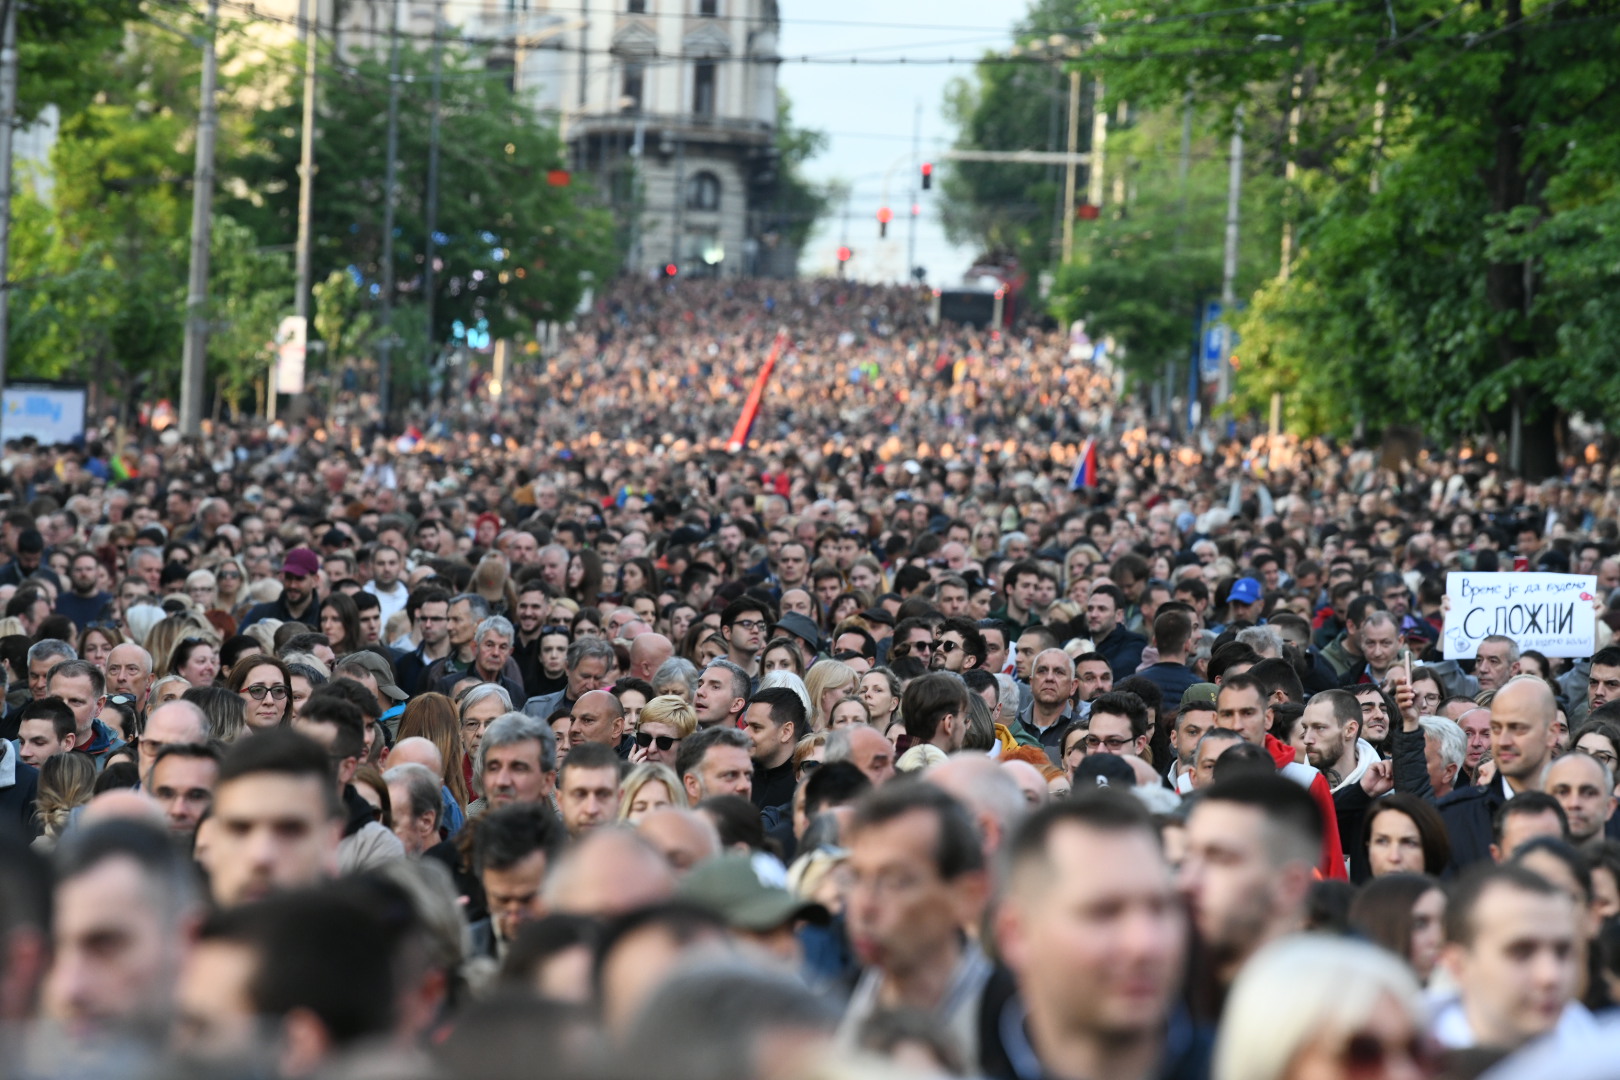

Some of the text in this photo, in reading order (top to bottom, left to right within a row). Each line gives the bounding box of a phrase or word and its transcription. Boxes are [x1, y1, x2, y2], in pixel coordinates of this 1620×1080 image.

[1461, 577, 1501, 603] Време
[1505, 582, 1519, 599] је
[1524, 582, 1540, 595] да
[1464, 602, 1574, 640] СЛОЖНИ
